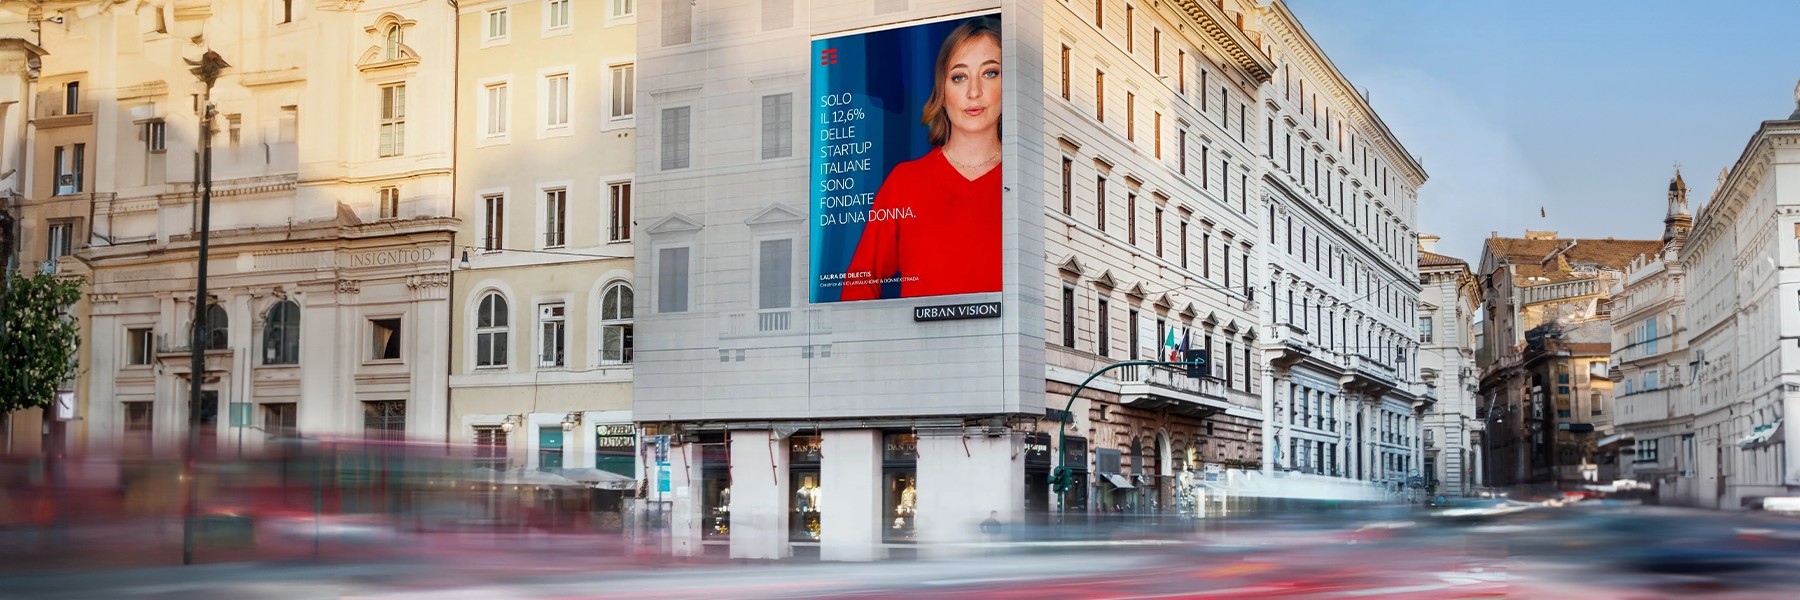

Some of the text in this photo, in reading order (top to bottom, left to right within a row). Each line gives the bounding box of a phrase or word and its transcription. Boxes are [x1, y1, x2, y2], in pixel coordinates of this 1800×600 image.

[820, 92, 852, 108] SOLO
[820, 107, 865, 124] IL 12,6%
[820, 125, 855, 141] DELLE
[820, 141, 872, 158] STARTUP
[820, 158, 871, 175] ITALIANE
[820, 177, 854, 192] SONO
[820, 192, 874, 209] FONDATE
[820, 206, 916, 227] DA UNA DONNA.
[916, 304, 998, 318] URBAN VISION
[887, 443, 904, 451] DAN
